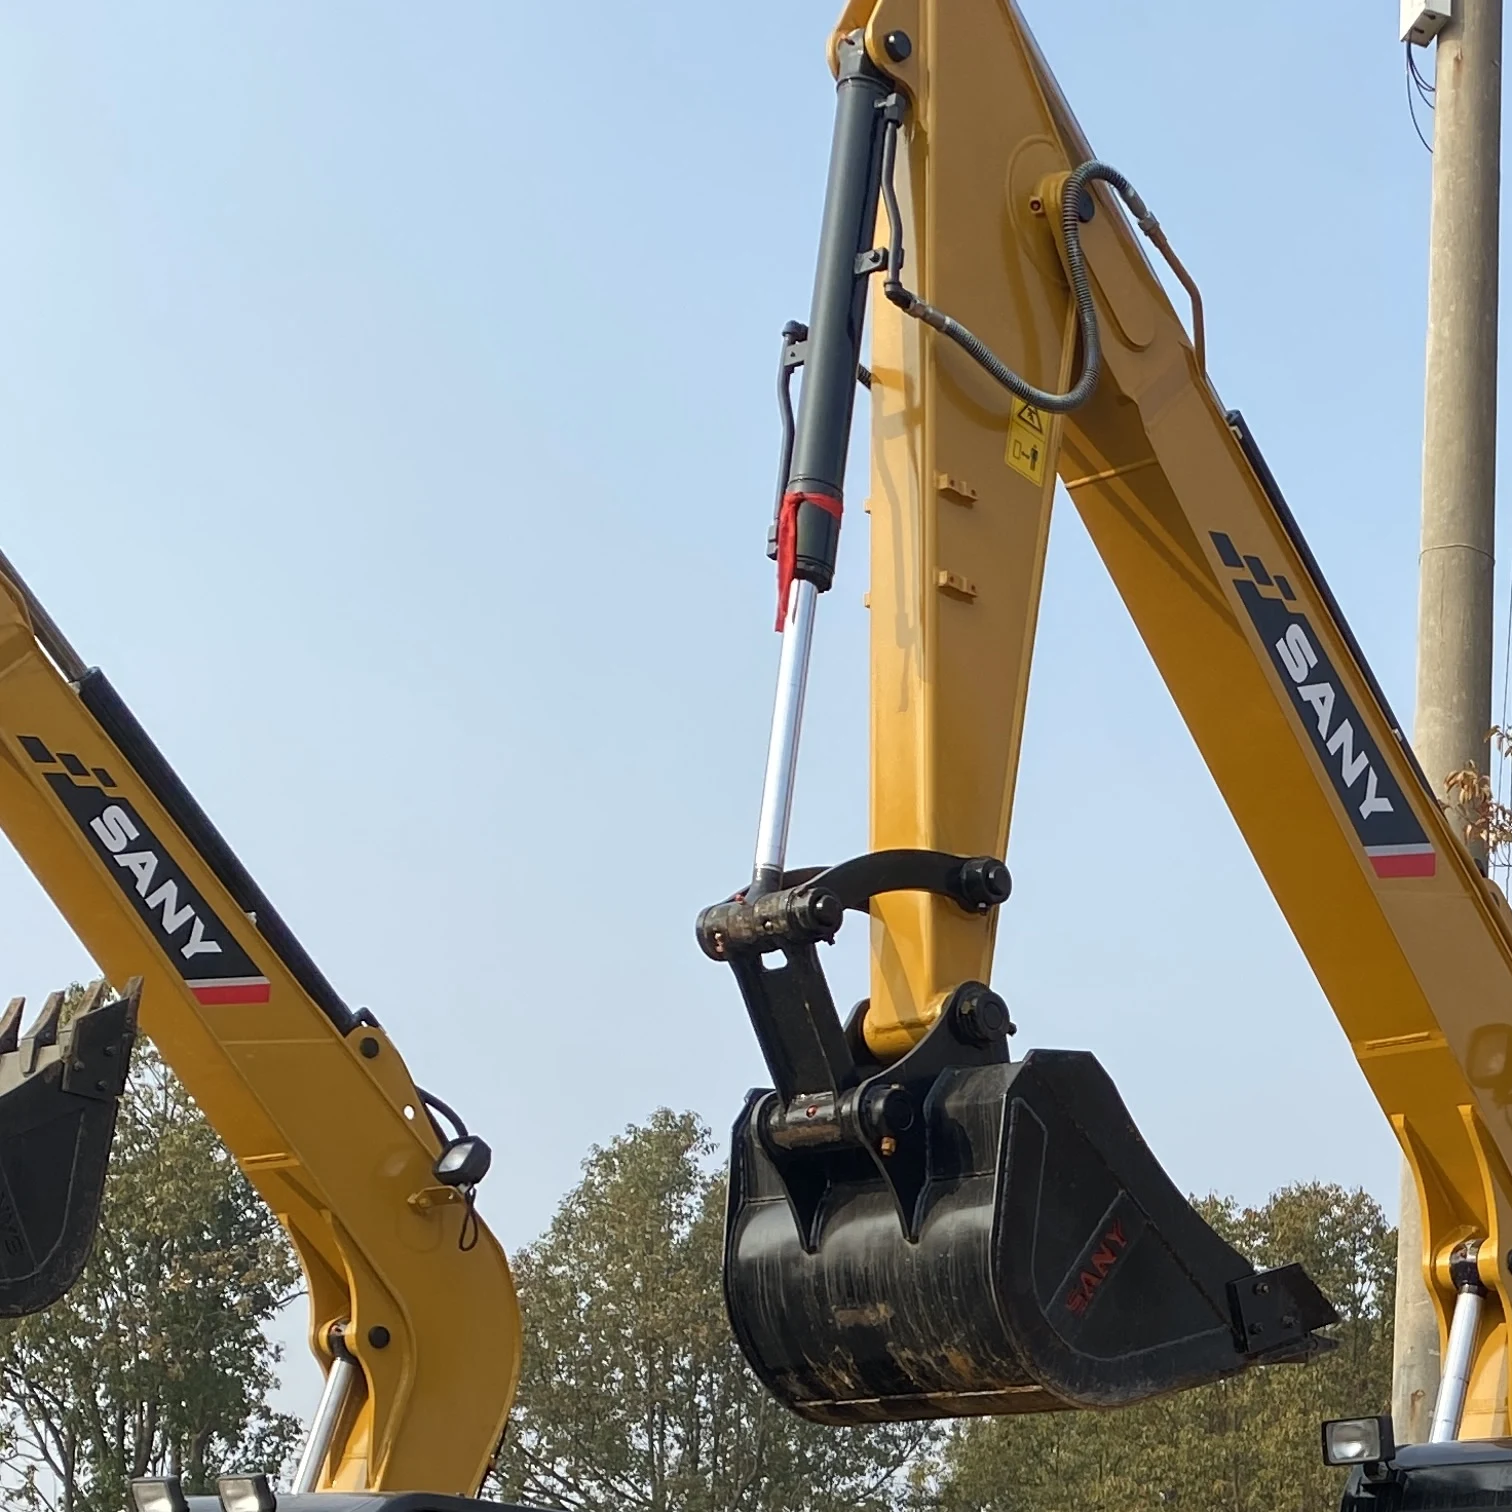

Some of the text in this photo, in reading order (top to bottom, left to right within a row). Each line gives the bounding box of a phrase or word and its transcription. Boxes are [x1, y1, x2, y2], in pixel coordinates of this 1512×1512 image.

[1275, 623, 1394, 820] SANY
[89, 804, 223, 960] SANY
[1064, 1217, 1127, 1318] SANY
